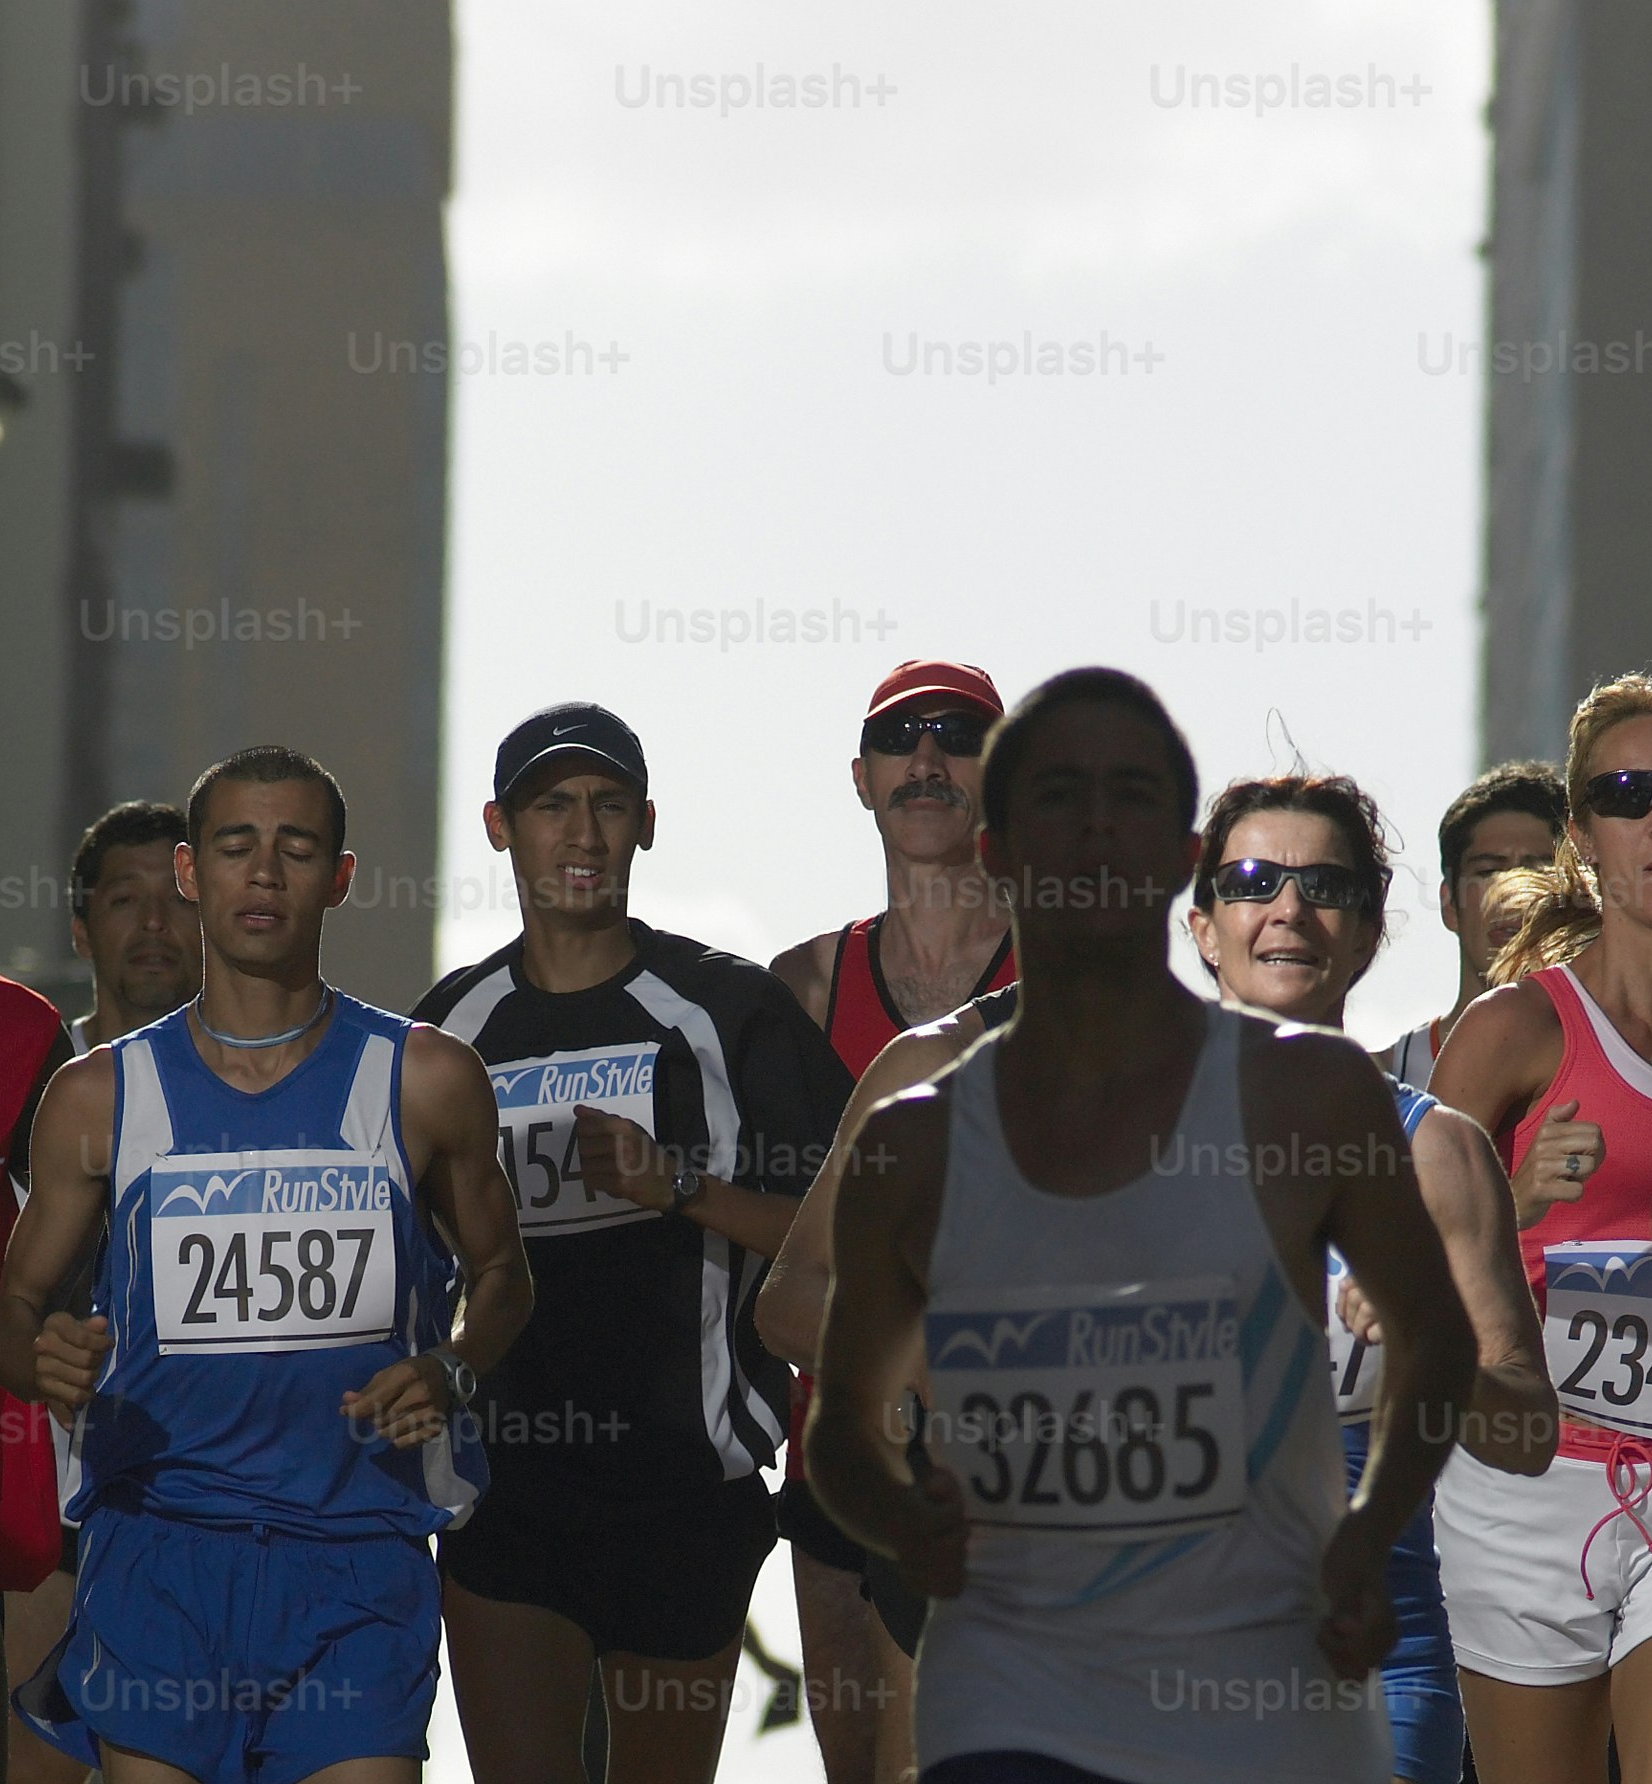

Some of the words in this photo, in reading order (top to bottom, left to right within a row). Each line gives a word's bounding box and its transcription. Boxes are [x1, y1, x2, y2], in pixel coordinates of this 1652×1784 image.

[538, 1054, 652, 1104] RunStyle
[261, 1166, 390, 1213] RunStyle
[179, 1229, 375, 1324] 24587
[1064, 1299, 1239, 1366] RunStyle
[959, 1382, 1219, 1505] 32685
